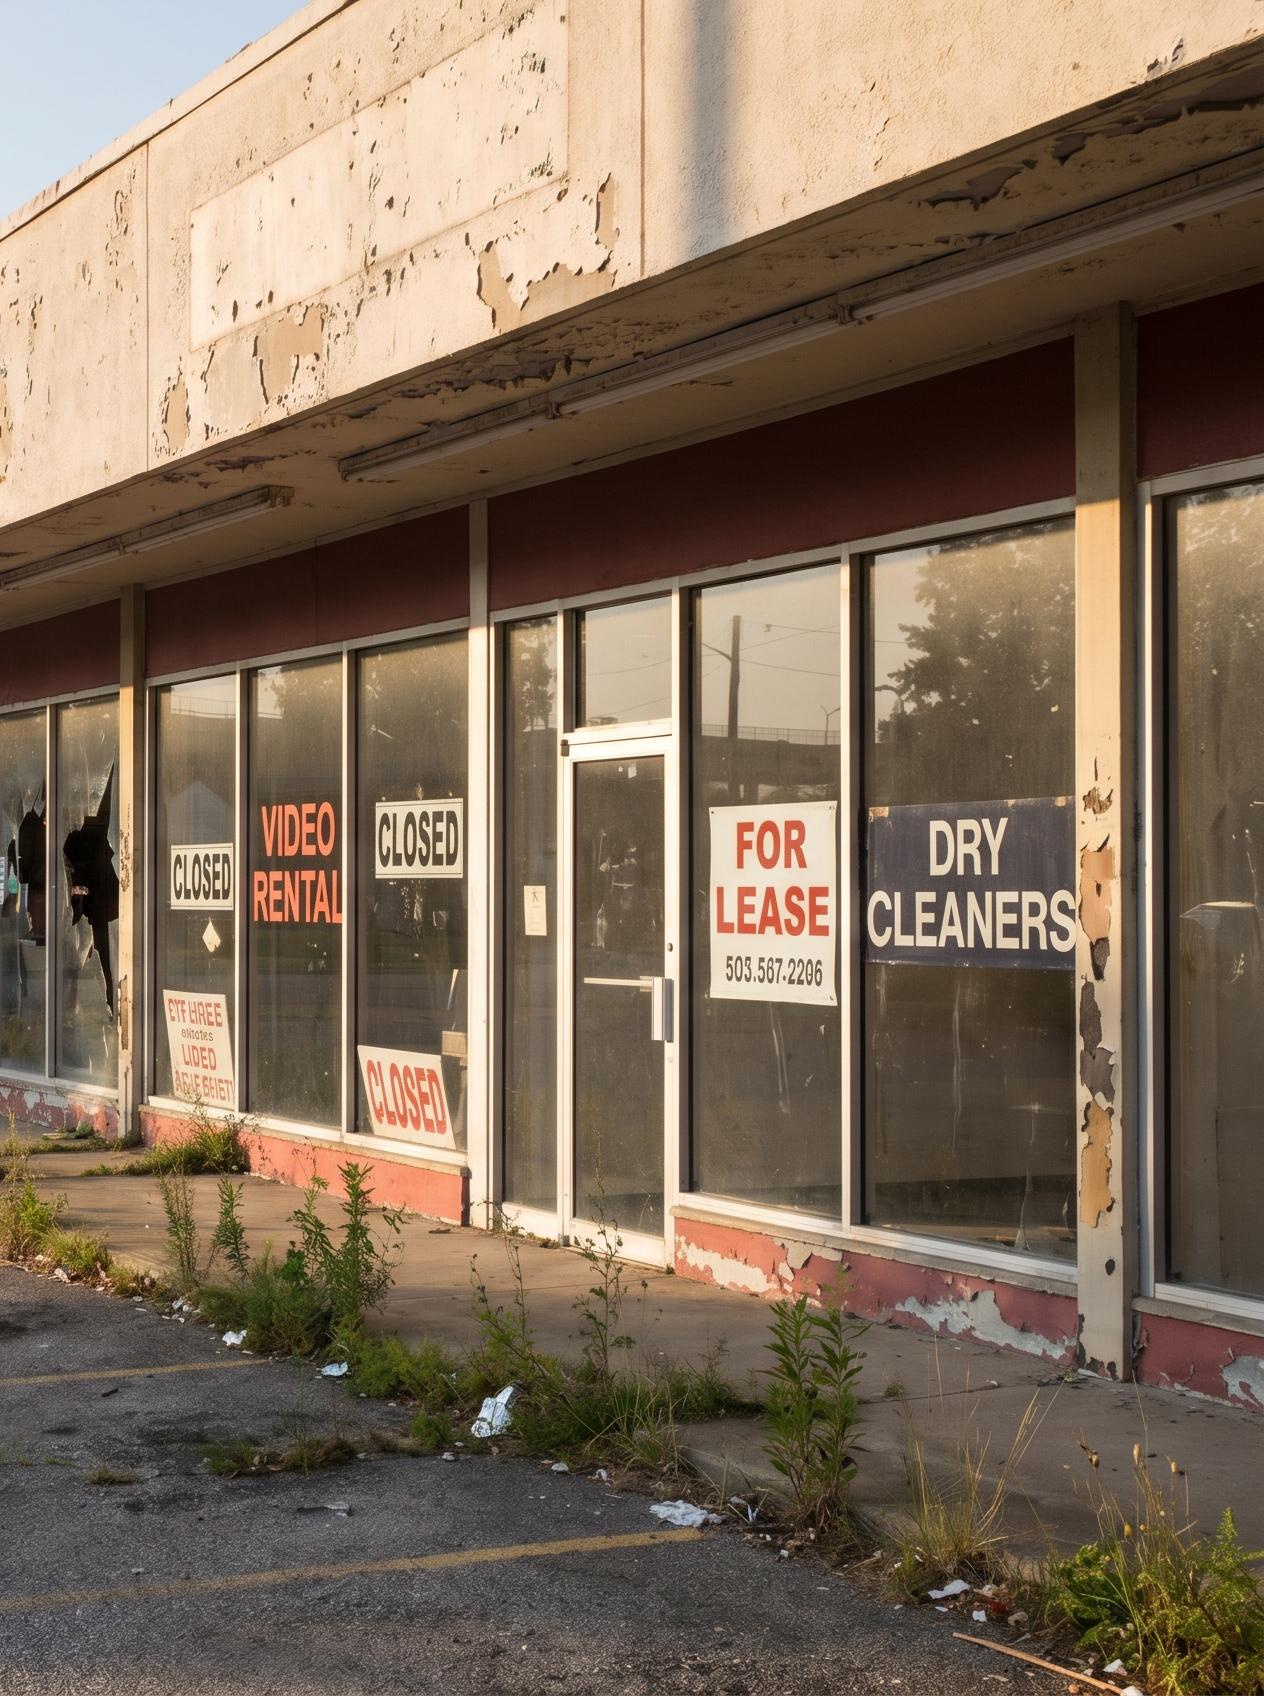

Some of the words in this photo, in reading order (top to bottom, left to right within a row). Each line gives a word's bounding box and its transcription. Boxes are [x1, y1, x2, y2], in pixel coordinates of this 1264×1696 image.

[261, 802, 337, 857] VIDEO
[378, 810, 459, 868] CLOSED
[736, 819, 807, 870] FOR
[929, 817, 1009, 876] DRY
[173, 853, 231, 901] CLOSED
[253, 869, 343, 925] RENTAL
[715, 885, 830, 937] LEASE
[867, 889, 1076, 953] CLEANERS
[366, 1058, 447, 1136] CLOSED
